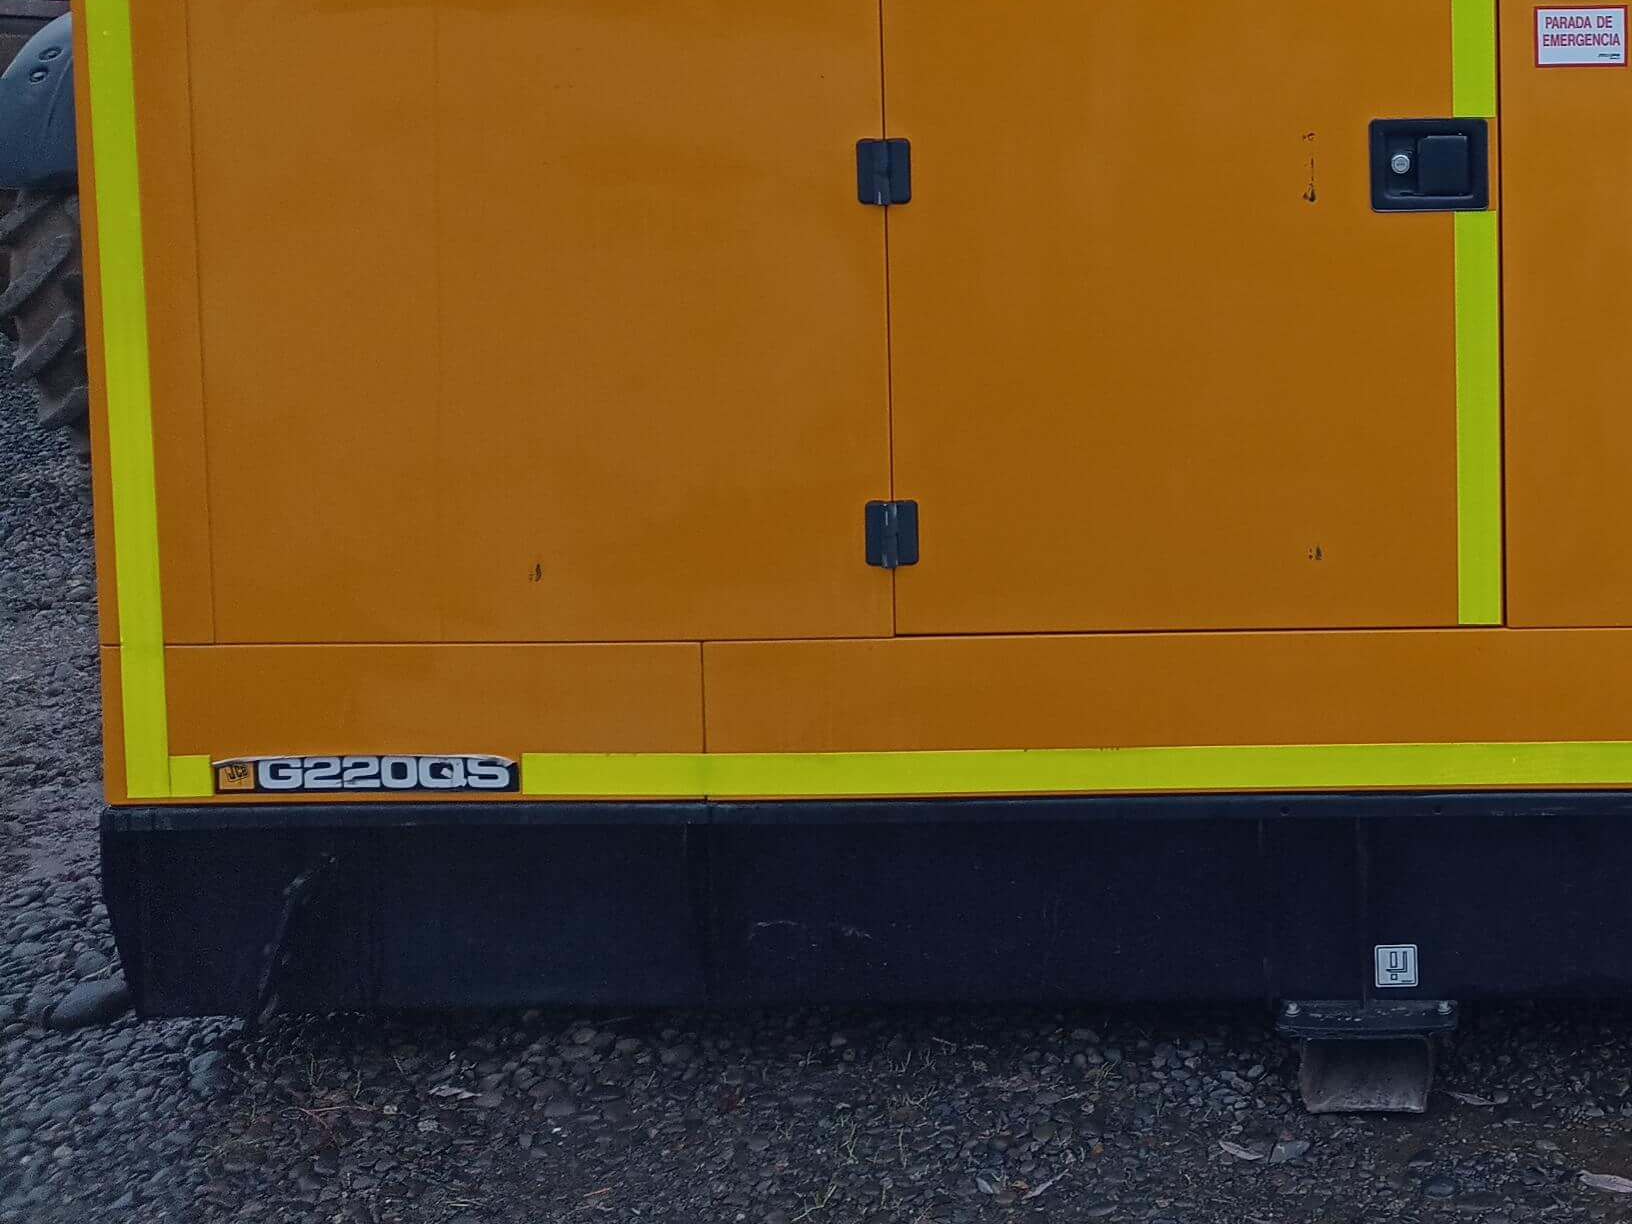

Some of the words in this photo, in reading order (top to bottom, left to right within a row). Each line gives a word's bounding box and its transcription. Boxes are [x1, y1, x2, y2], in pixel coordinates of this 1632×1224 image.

[1545, 16, 1592, 29] PARADA
[1597, 15, 1613, 28] DE
[1543, 33, 1621, 46] EMERGENCIA
[258, 757, 509, 789] G220QS
